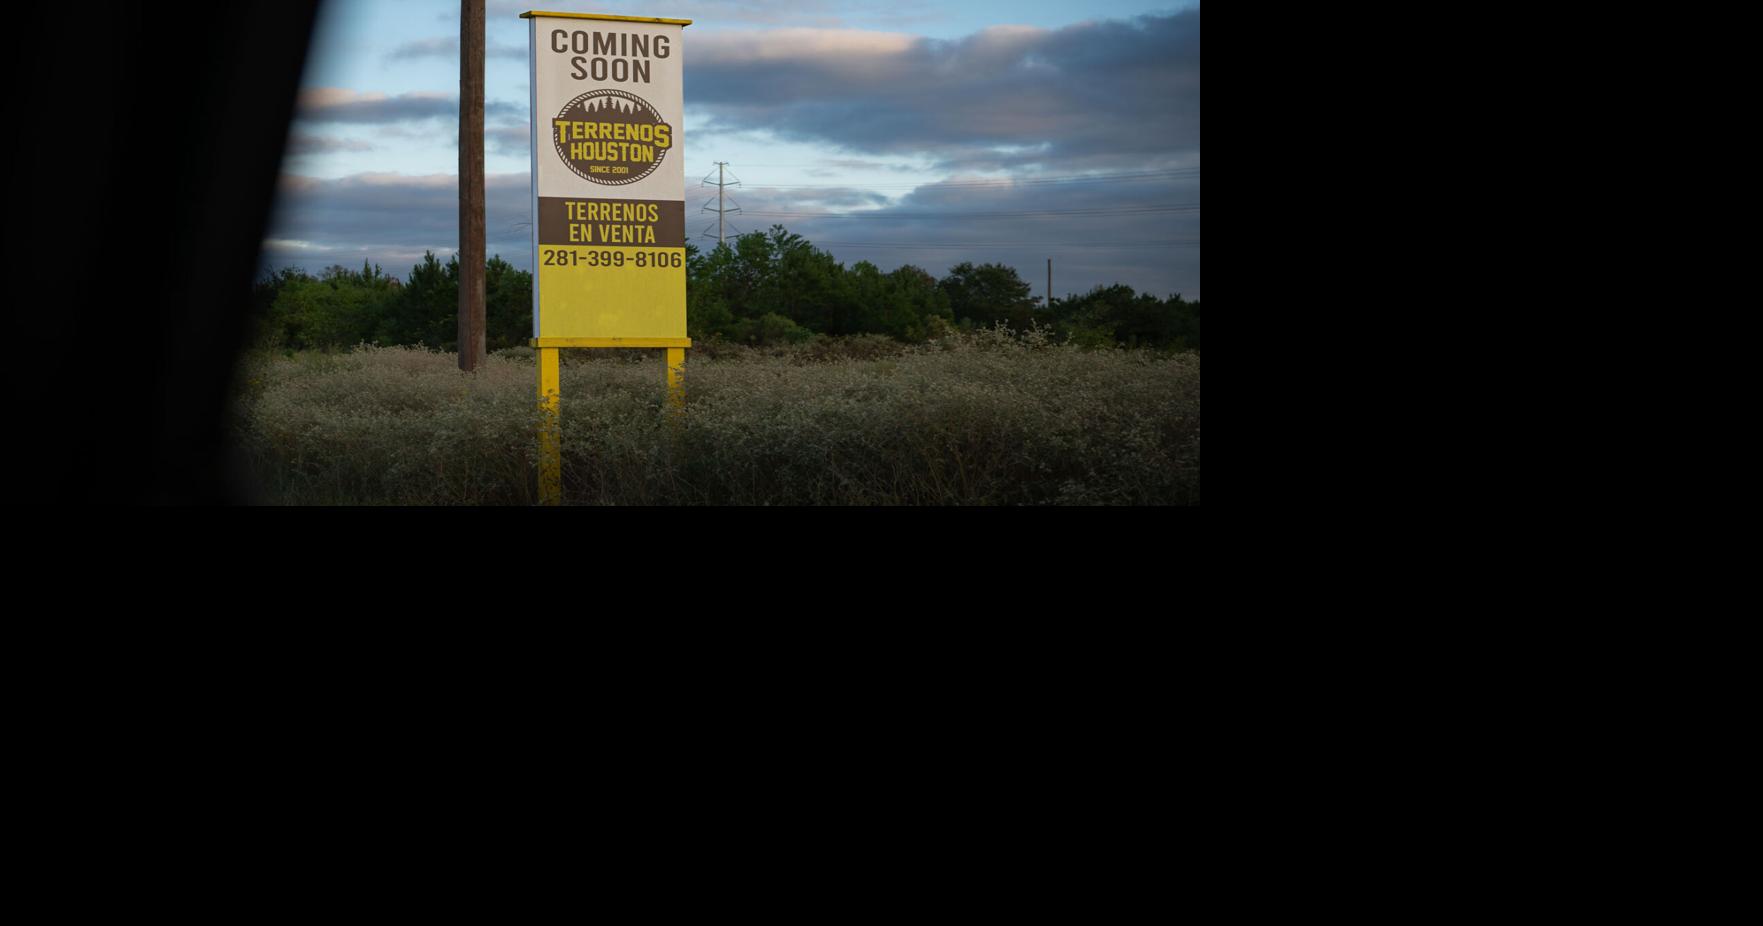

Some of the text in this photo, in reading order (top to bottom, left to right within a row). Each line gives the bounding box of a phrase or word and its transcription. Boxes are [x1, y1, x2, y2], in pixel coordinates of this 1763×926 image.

[551, 29, 670, 59] COMING
[571, 56, 651, 83] SOON
[555, 120, 670, 148] TERRENOS
[571, 142, 654, 162] HOUSTON
[590, 165, 629, 174] SINCE 2001
[565, 201, 659, 222] TERRENOS
[569, 223, 656, 243] EN VENTA
[543, 249, 682, 268] 281-399-8106
